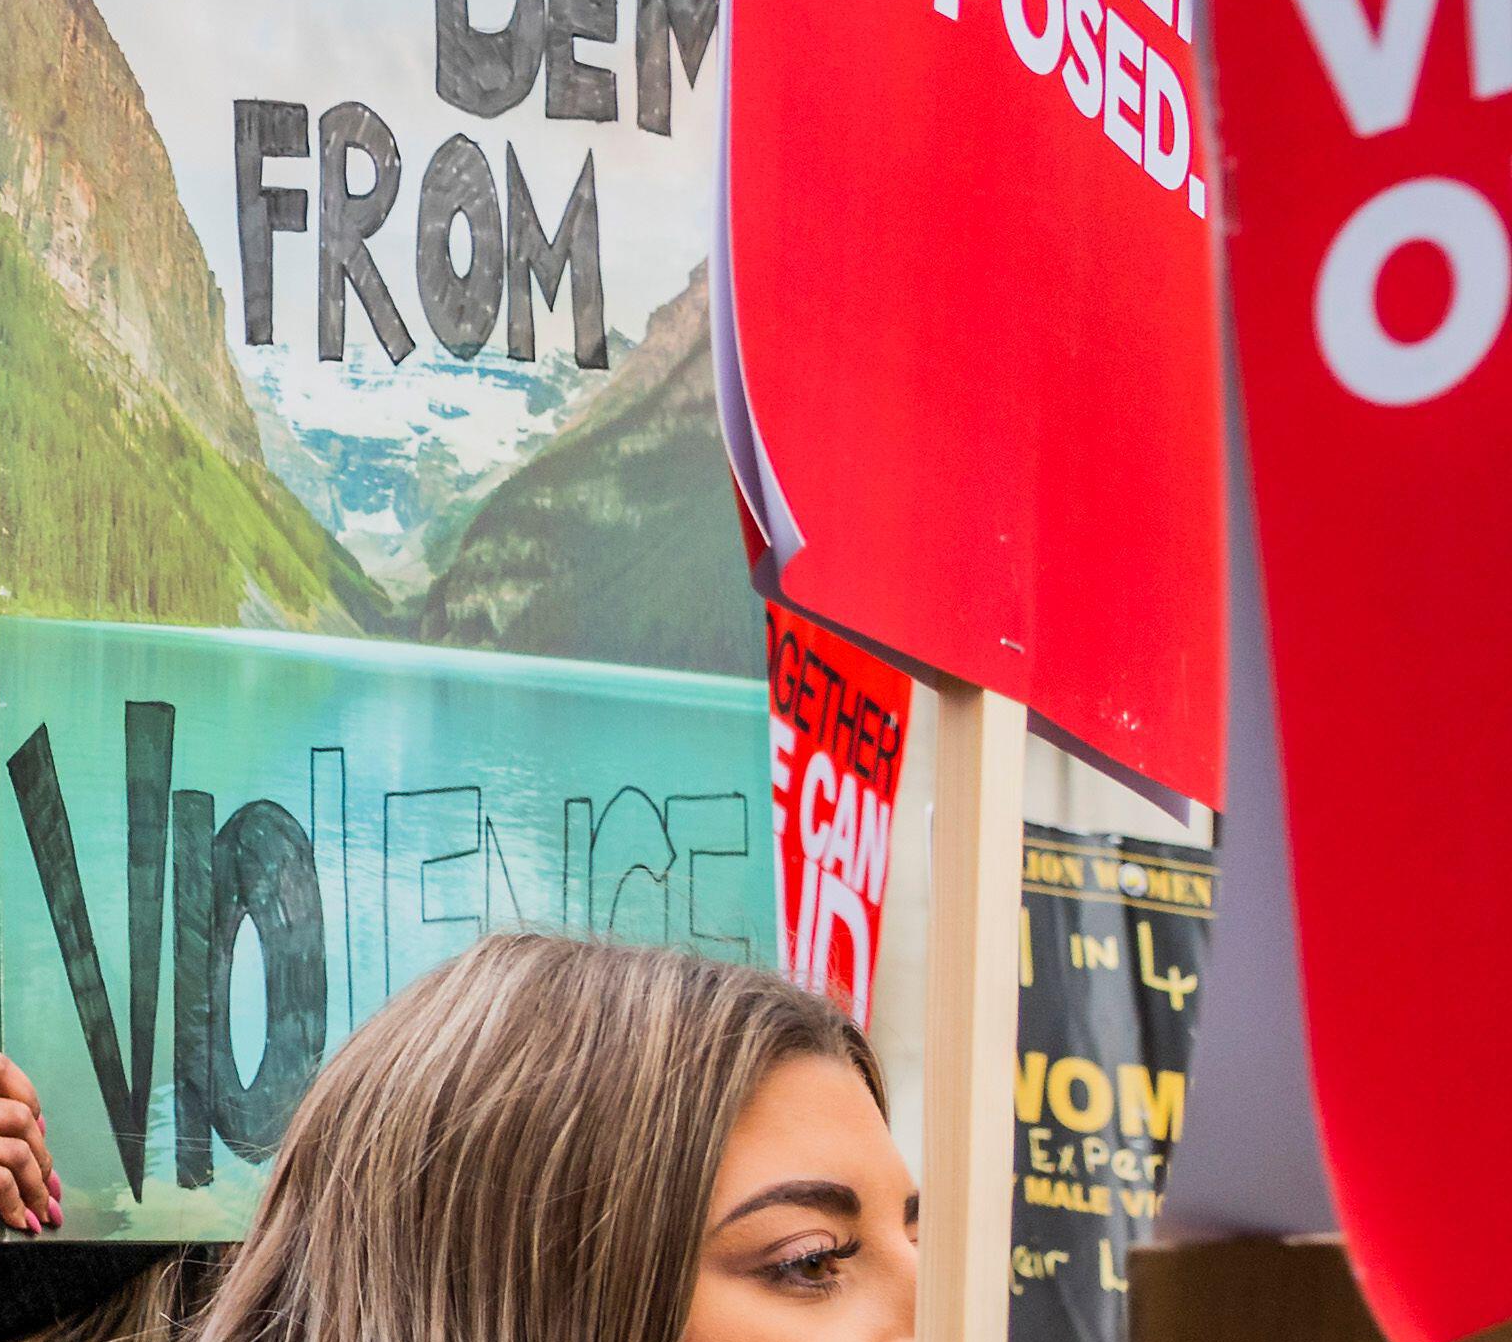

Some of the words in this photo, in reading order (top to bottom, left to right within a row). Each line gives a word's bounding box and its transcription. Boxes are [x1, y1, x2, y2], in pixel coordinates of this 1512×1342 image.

[235, 99, 607, 369] FROM
[767, 614, 902, 795] GETHER
[799, 751, 892, 908] CAN
[1069, 932, 1120, 972] IN
[1136, 920, 1199, 1012] 4
[1023, 1174, 1113, 1218] MALE
